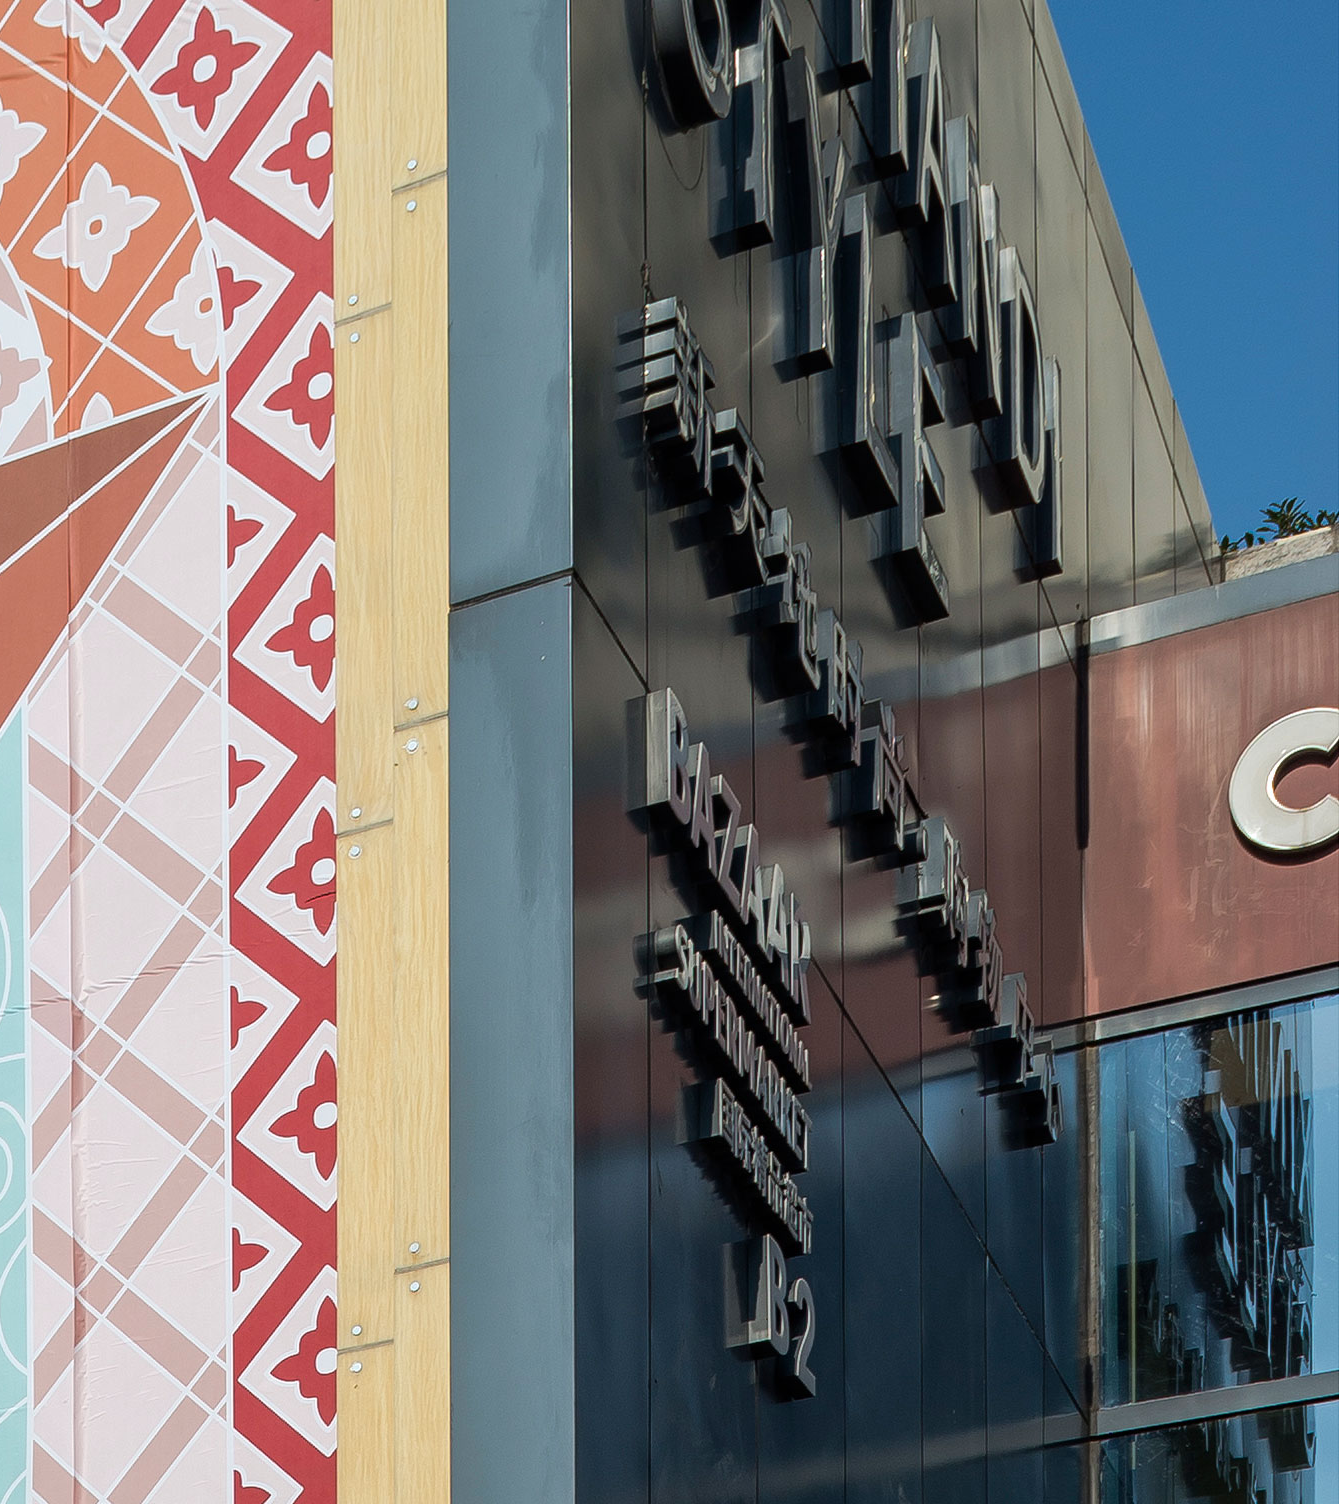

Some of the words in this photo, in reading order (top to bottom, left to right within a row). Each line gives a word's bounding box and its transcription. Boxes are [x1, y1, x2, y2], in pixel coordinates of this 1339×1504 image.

[649, 687, 811, 1025] BAZAAR
[665, 924, 813, 1173] SUPERMARKET
[757, 1233, 816, 1396] B2
